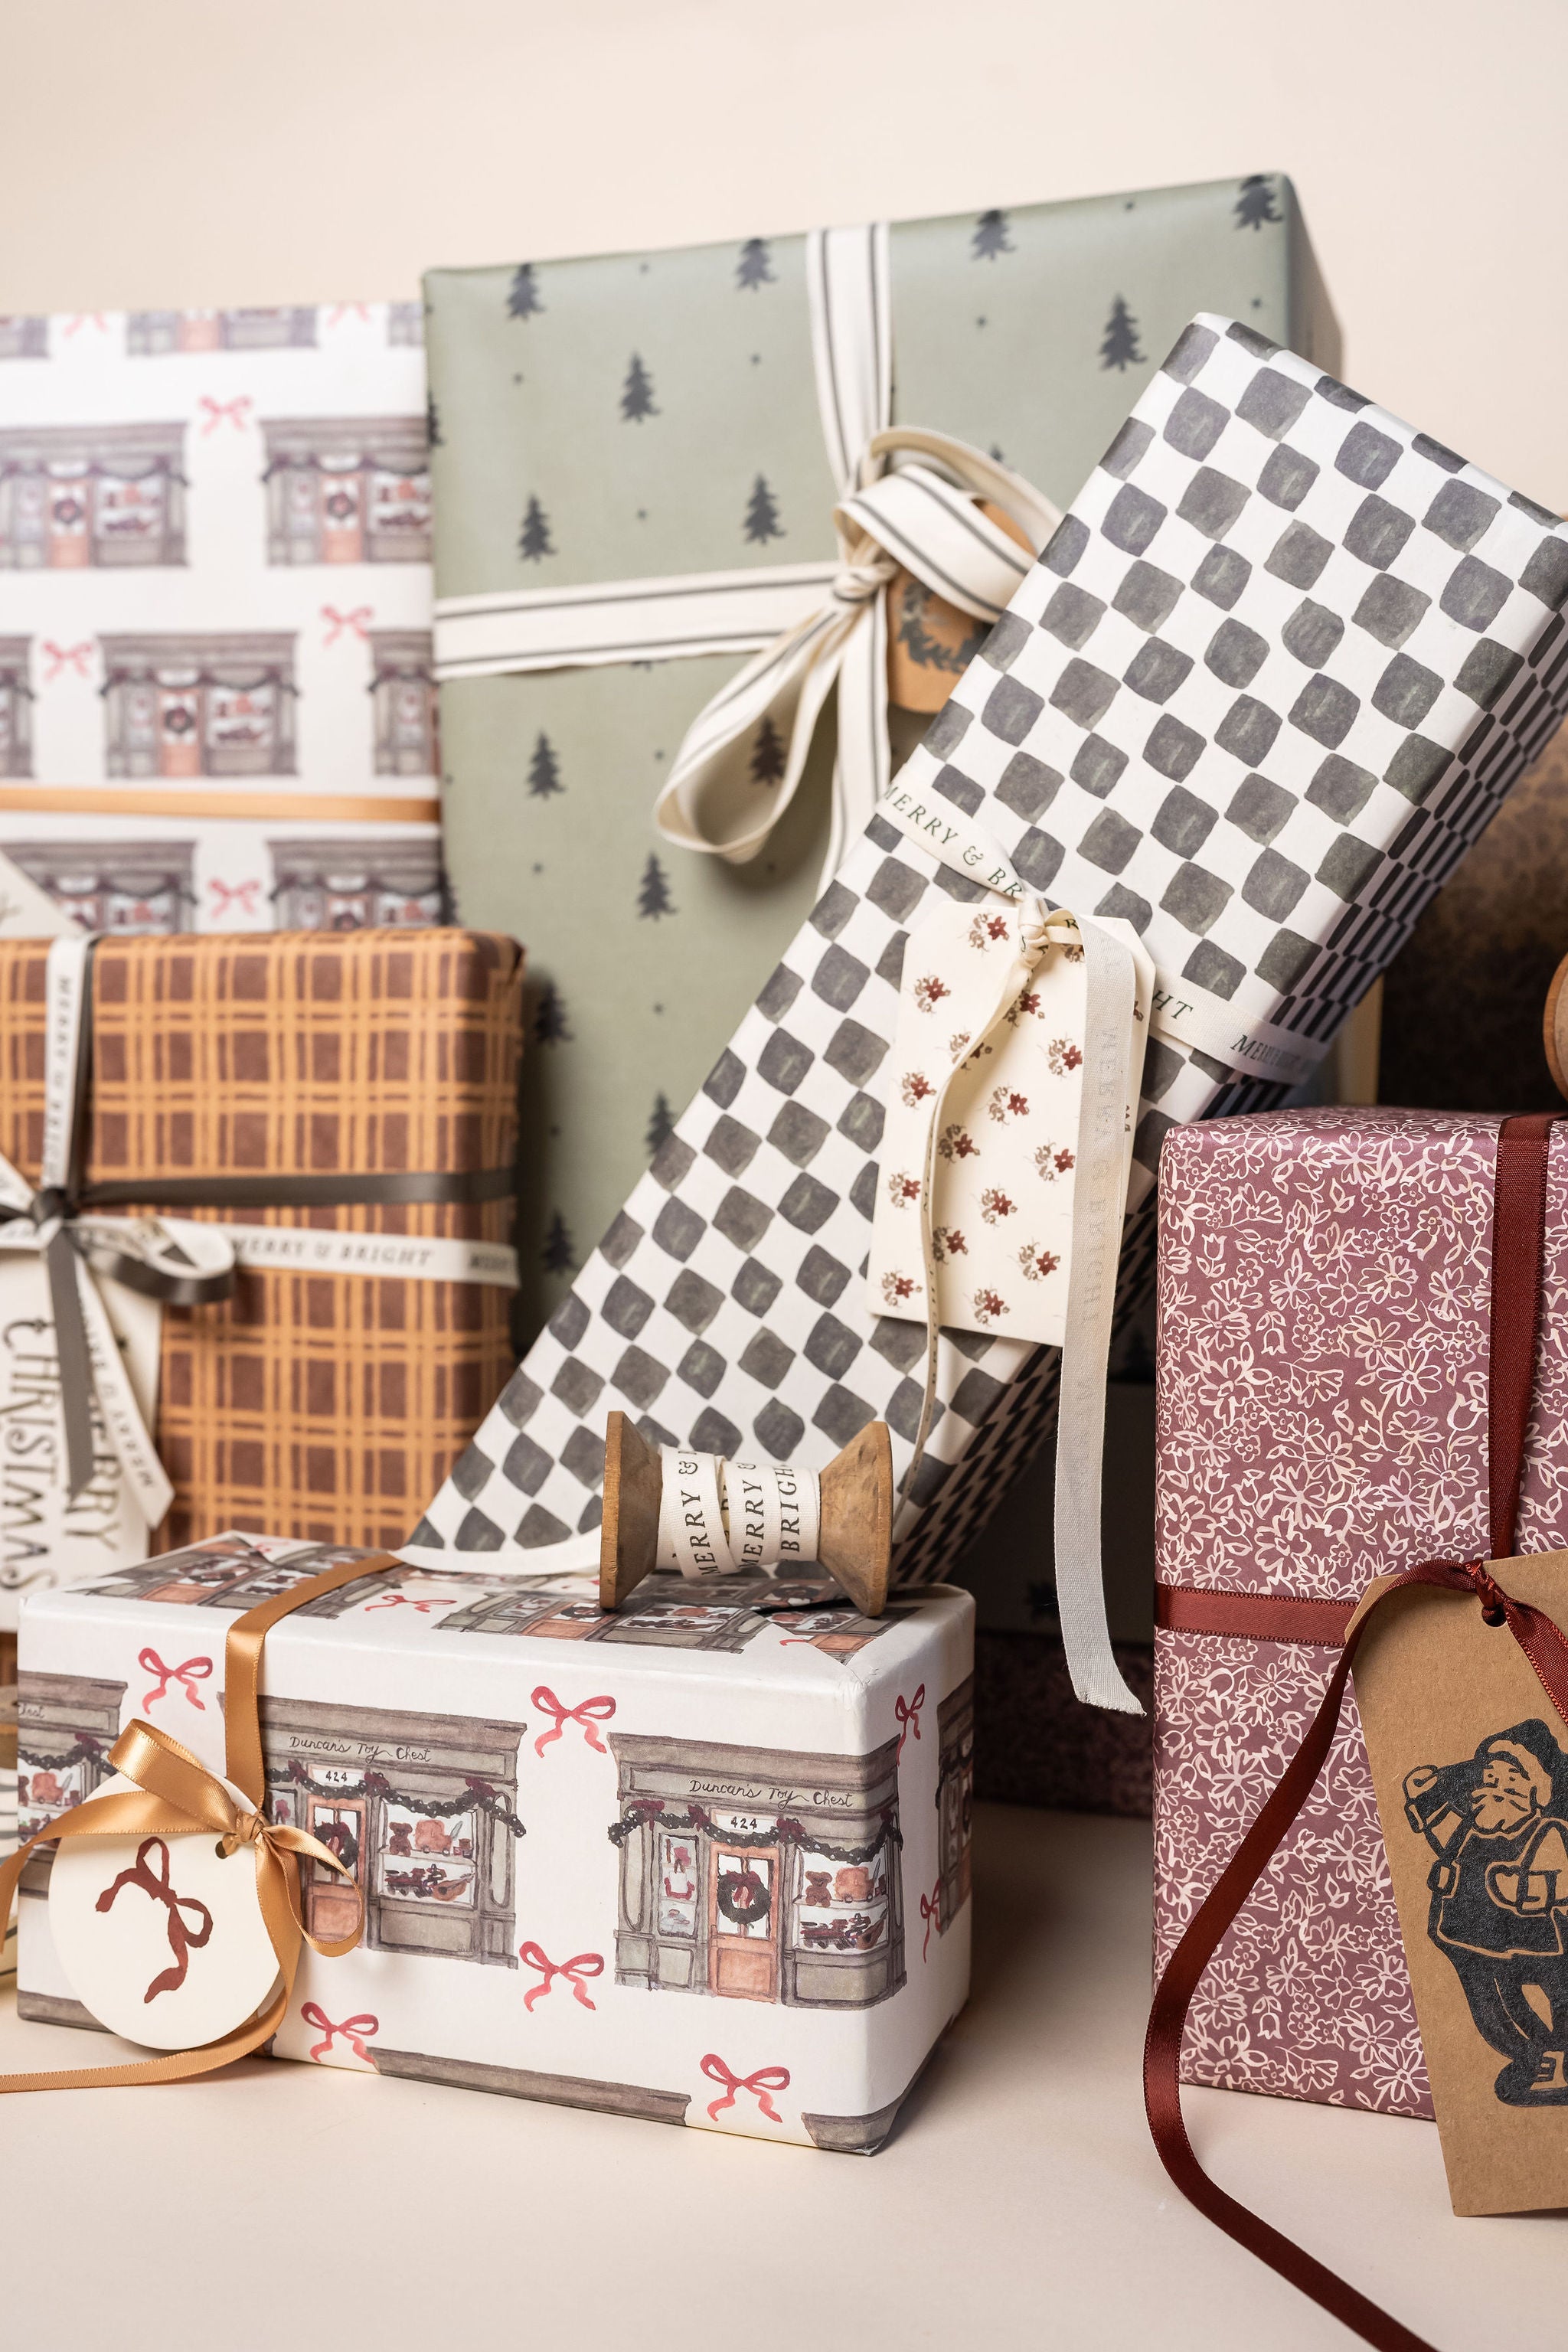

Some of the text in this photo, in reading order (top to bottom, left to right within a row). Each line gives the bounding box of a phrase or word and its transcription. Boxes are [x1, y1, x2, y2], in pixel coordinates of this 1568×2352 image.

[962, 845, 984, 866] &
[678, 1460, 698, 1475] &
[773, 1465, 801, 1552] BRIGH
[680, 1490, 722, 1576] MERRY
[289, 1735, 432, 1765] Duncan's Toy Chest
[325, 1770, 348, 1782] 424
[688, 1779, 854, 1809] Duncan's Toy Chest
[730, 1815, 758, 1831] 424
